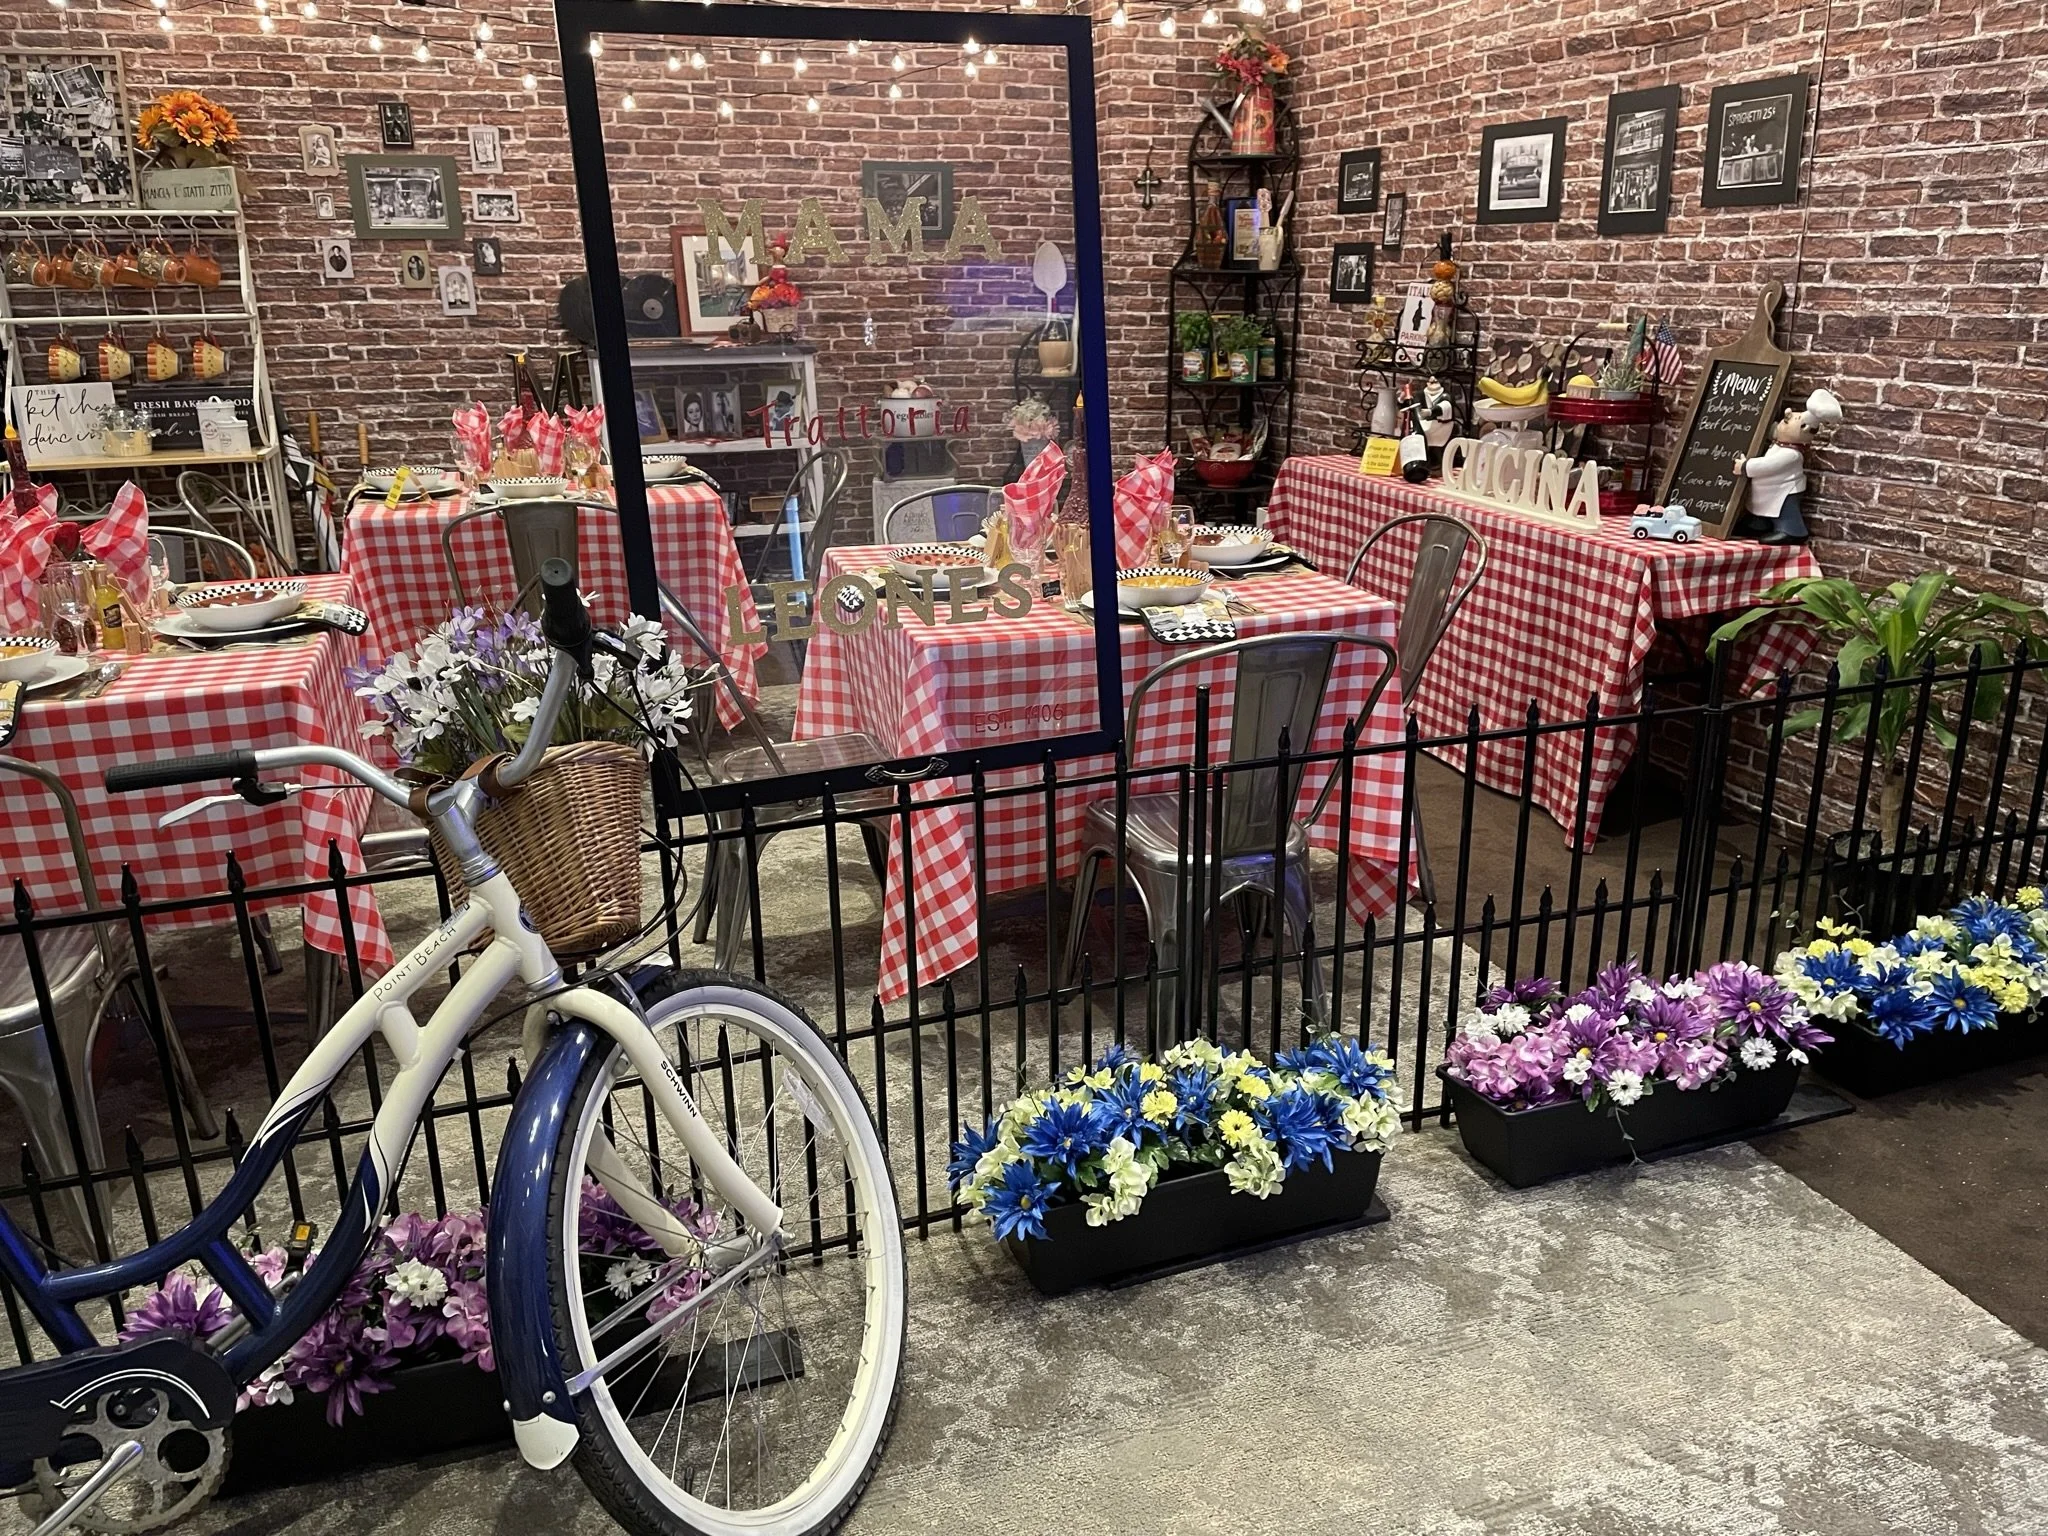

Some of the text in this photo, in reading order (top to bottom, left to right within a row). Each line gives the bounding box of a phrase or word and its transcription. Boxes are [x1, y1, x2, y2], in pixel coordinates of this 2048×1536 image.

[183, 185, 205, 198] STATTI
[210, 183, 232, 197] ZITTO
[695, 195, 1003, 265] MAMA
[34, 388, 57, 396] THIS
[134, 401, 170, 410] FRESH
[1720, 372, 1767, 397] Menu
[746, 399, 972, 449] Trattoria
[1442, 437, 1601, 527] CUCINA
[723, 563, 1033, 646] LEONES
[974, 703, 1064, 733] EST. 1906
[373, 927, 457, 1002] POINT BEACH
[660, 1060, 697, 1118] SCHWINN
